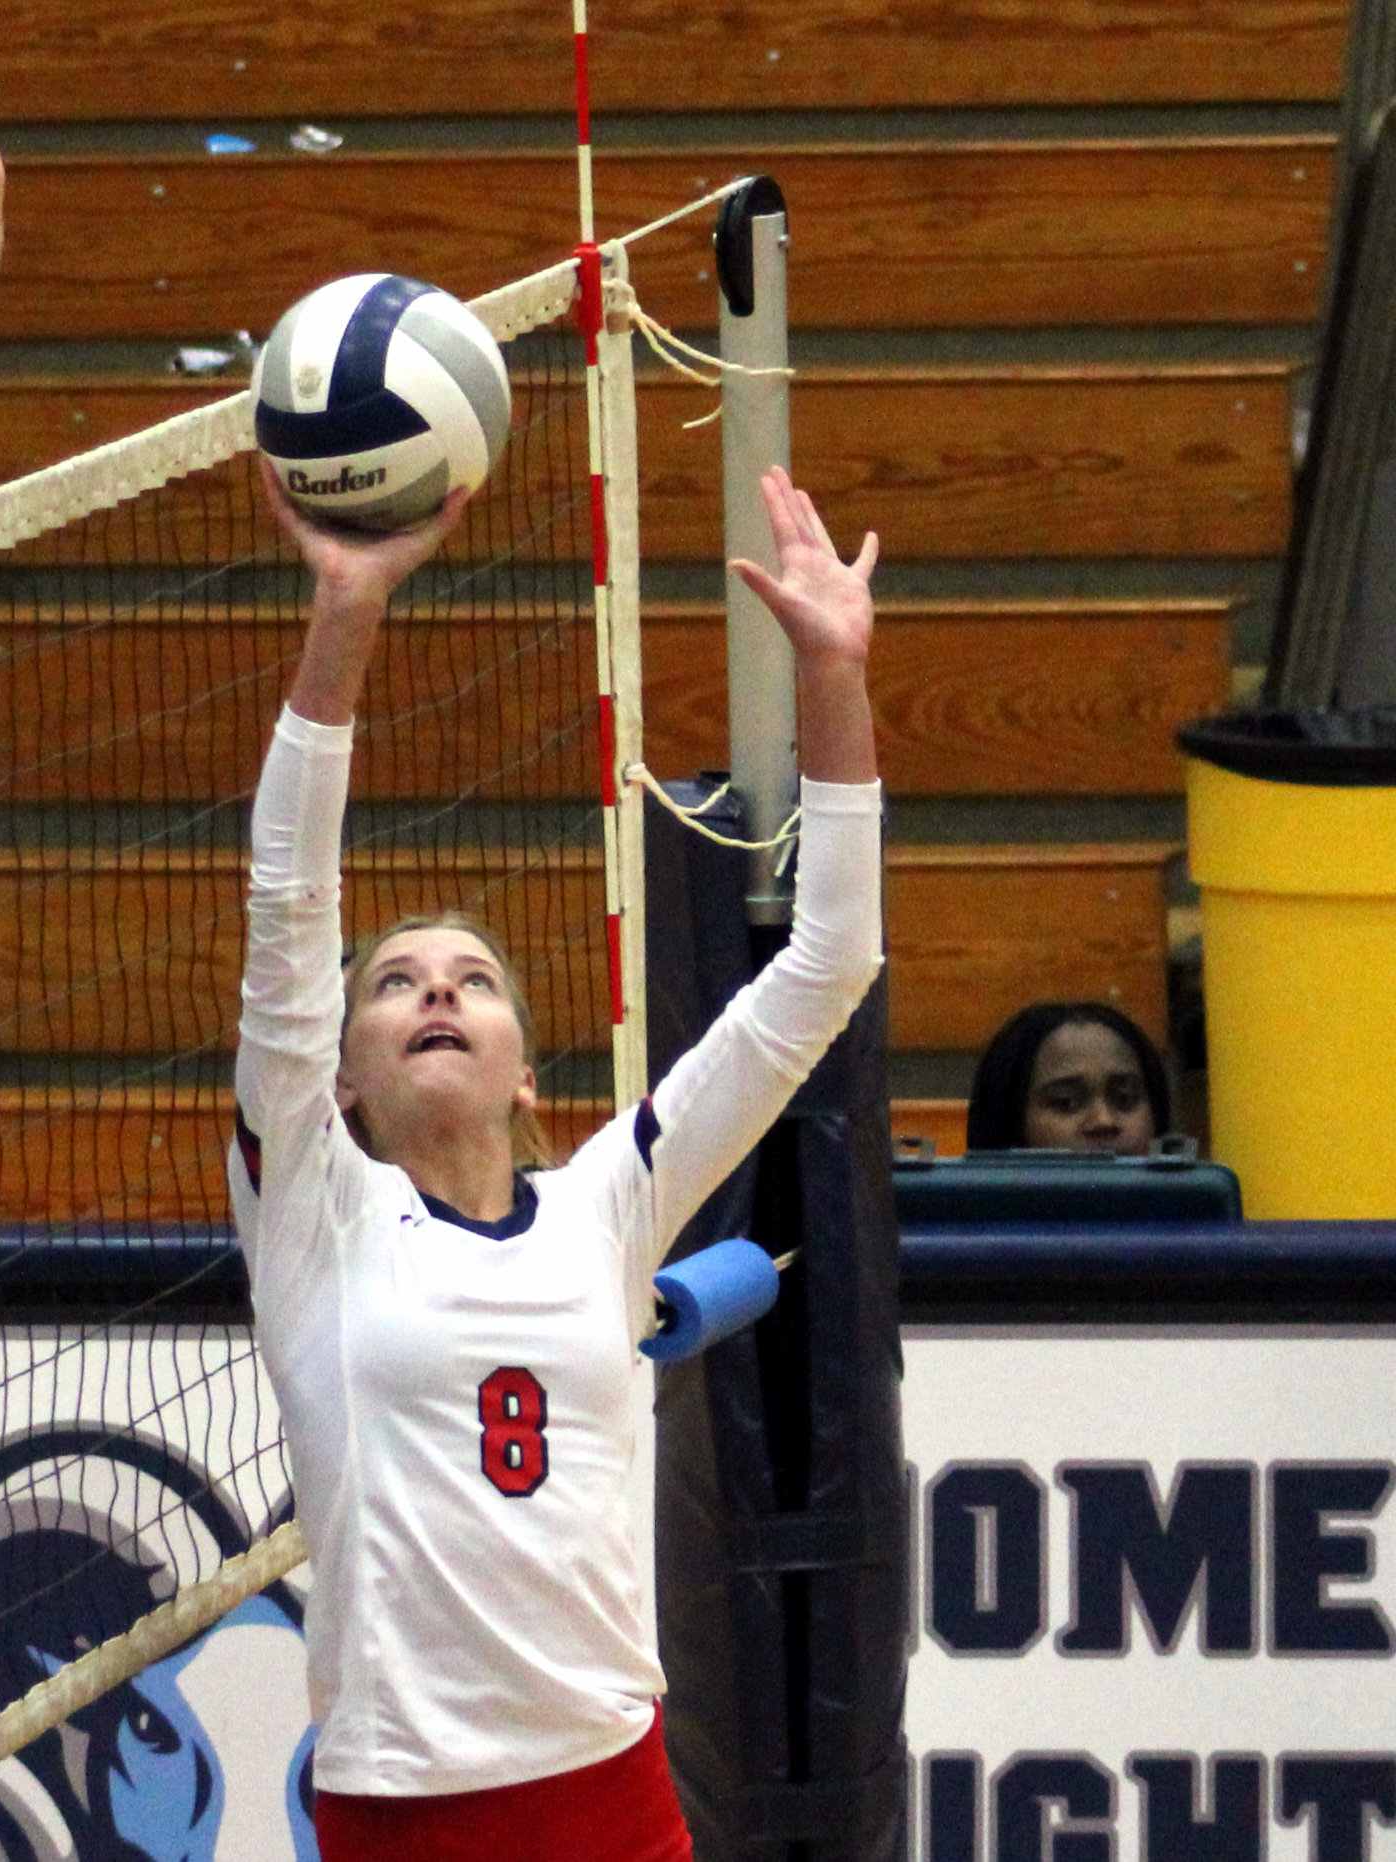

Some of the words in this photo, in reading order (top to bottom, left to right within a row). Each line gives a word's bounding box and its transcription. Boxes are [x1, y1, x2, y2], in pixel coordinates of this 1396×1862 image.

[288, 466, 386, 494] Baden
[477, 1365, 549, 1498] 8
[906, 1458, 1396, 1660] OME
[906, 1749, 1396, 1862] IGHT
